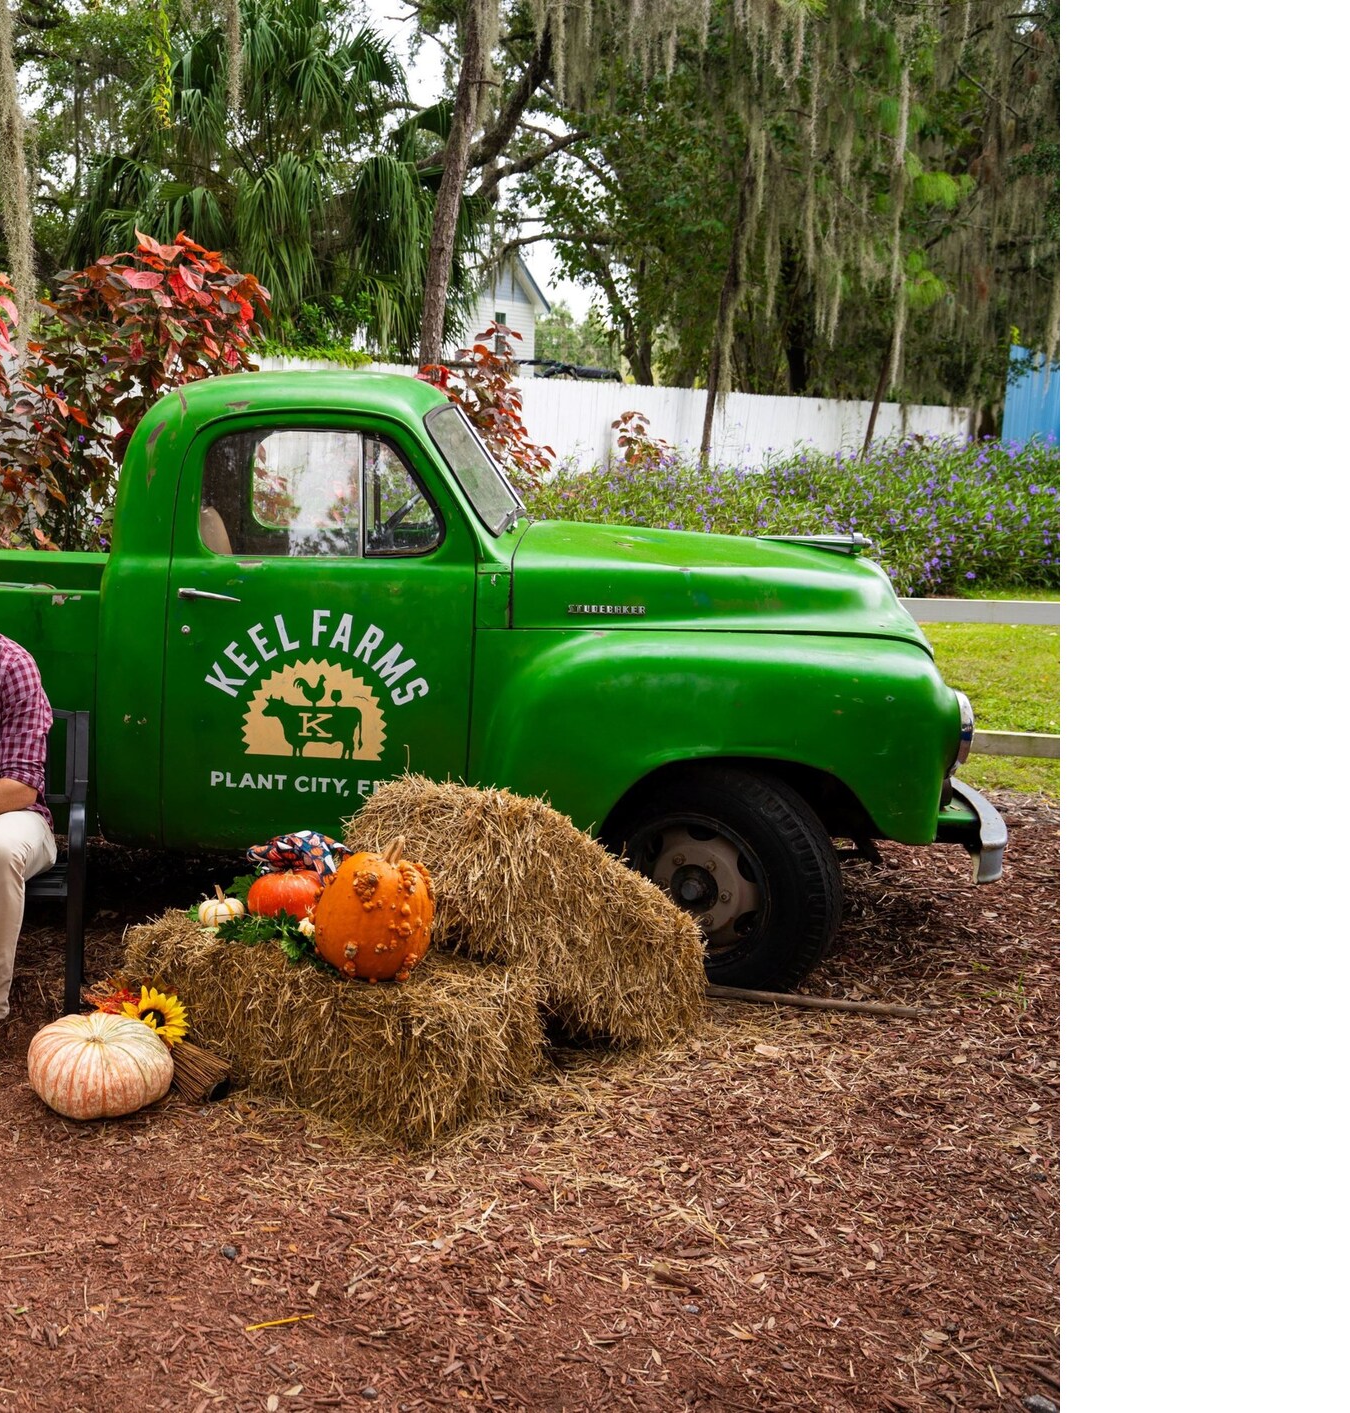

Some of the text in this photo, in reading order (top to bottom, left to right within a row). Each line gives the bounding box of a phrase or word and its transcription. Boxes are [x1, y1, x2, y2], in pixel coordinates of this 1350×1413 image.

[567, 604, 646, 614] STUDEBAKER
[204, 609, 430, 706] KEEL FARMS
[297, 712, 333, 738] K
[210, 770, 288, 790] PLANT
[294, 776, 350, 797] CITY,
